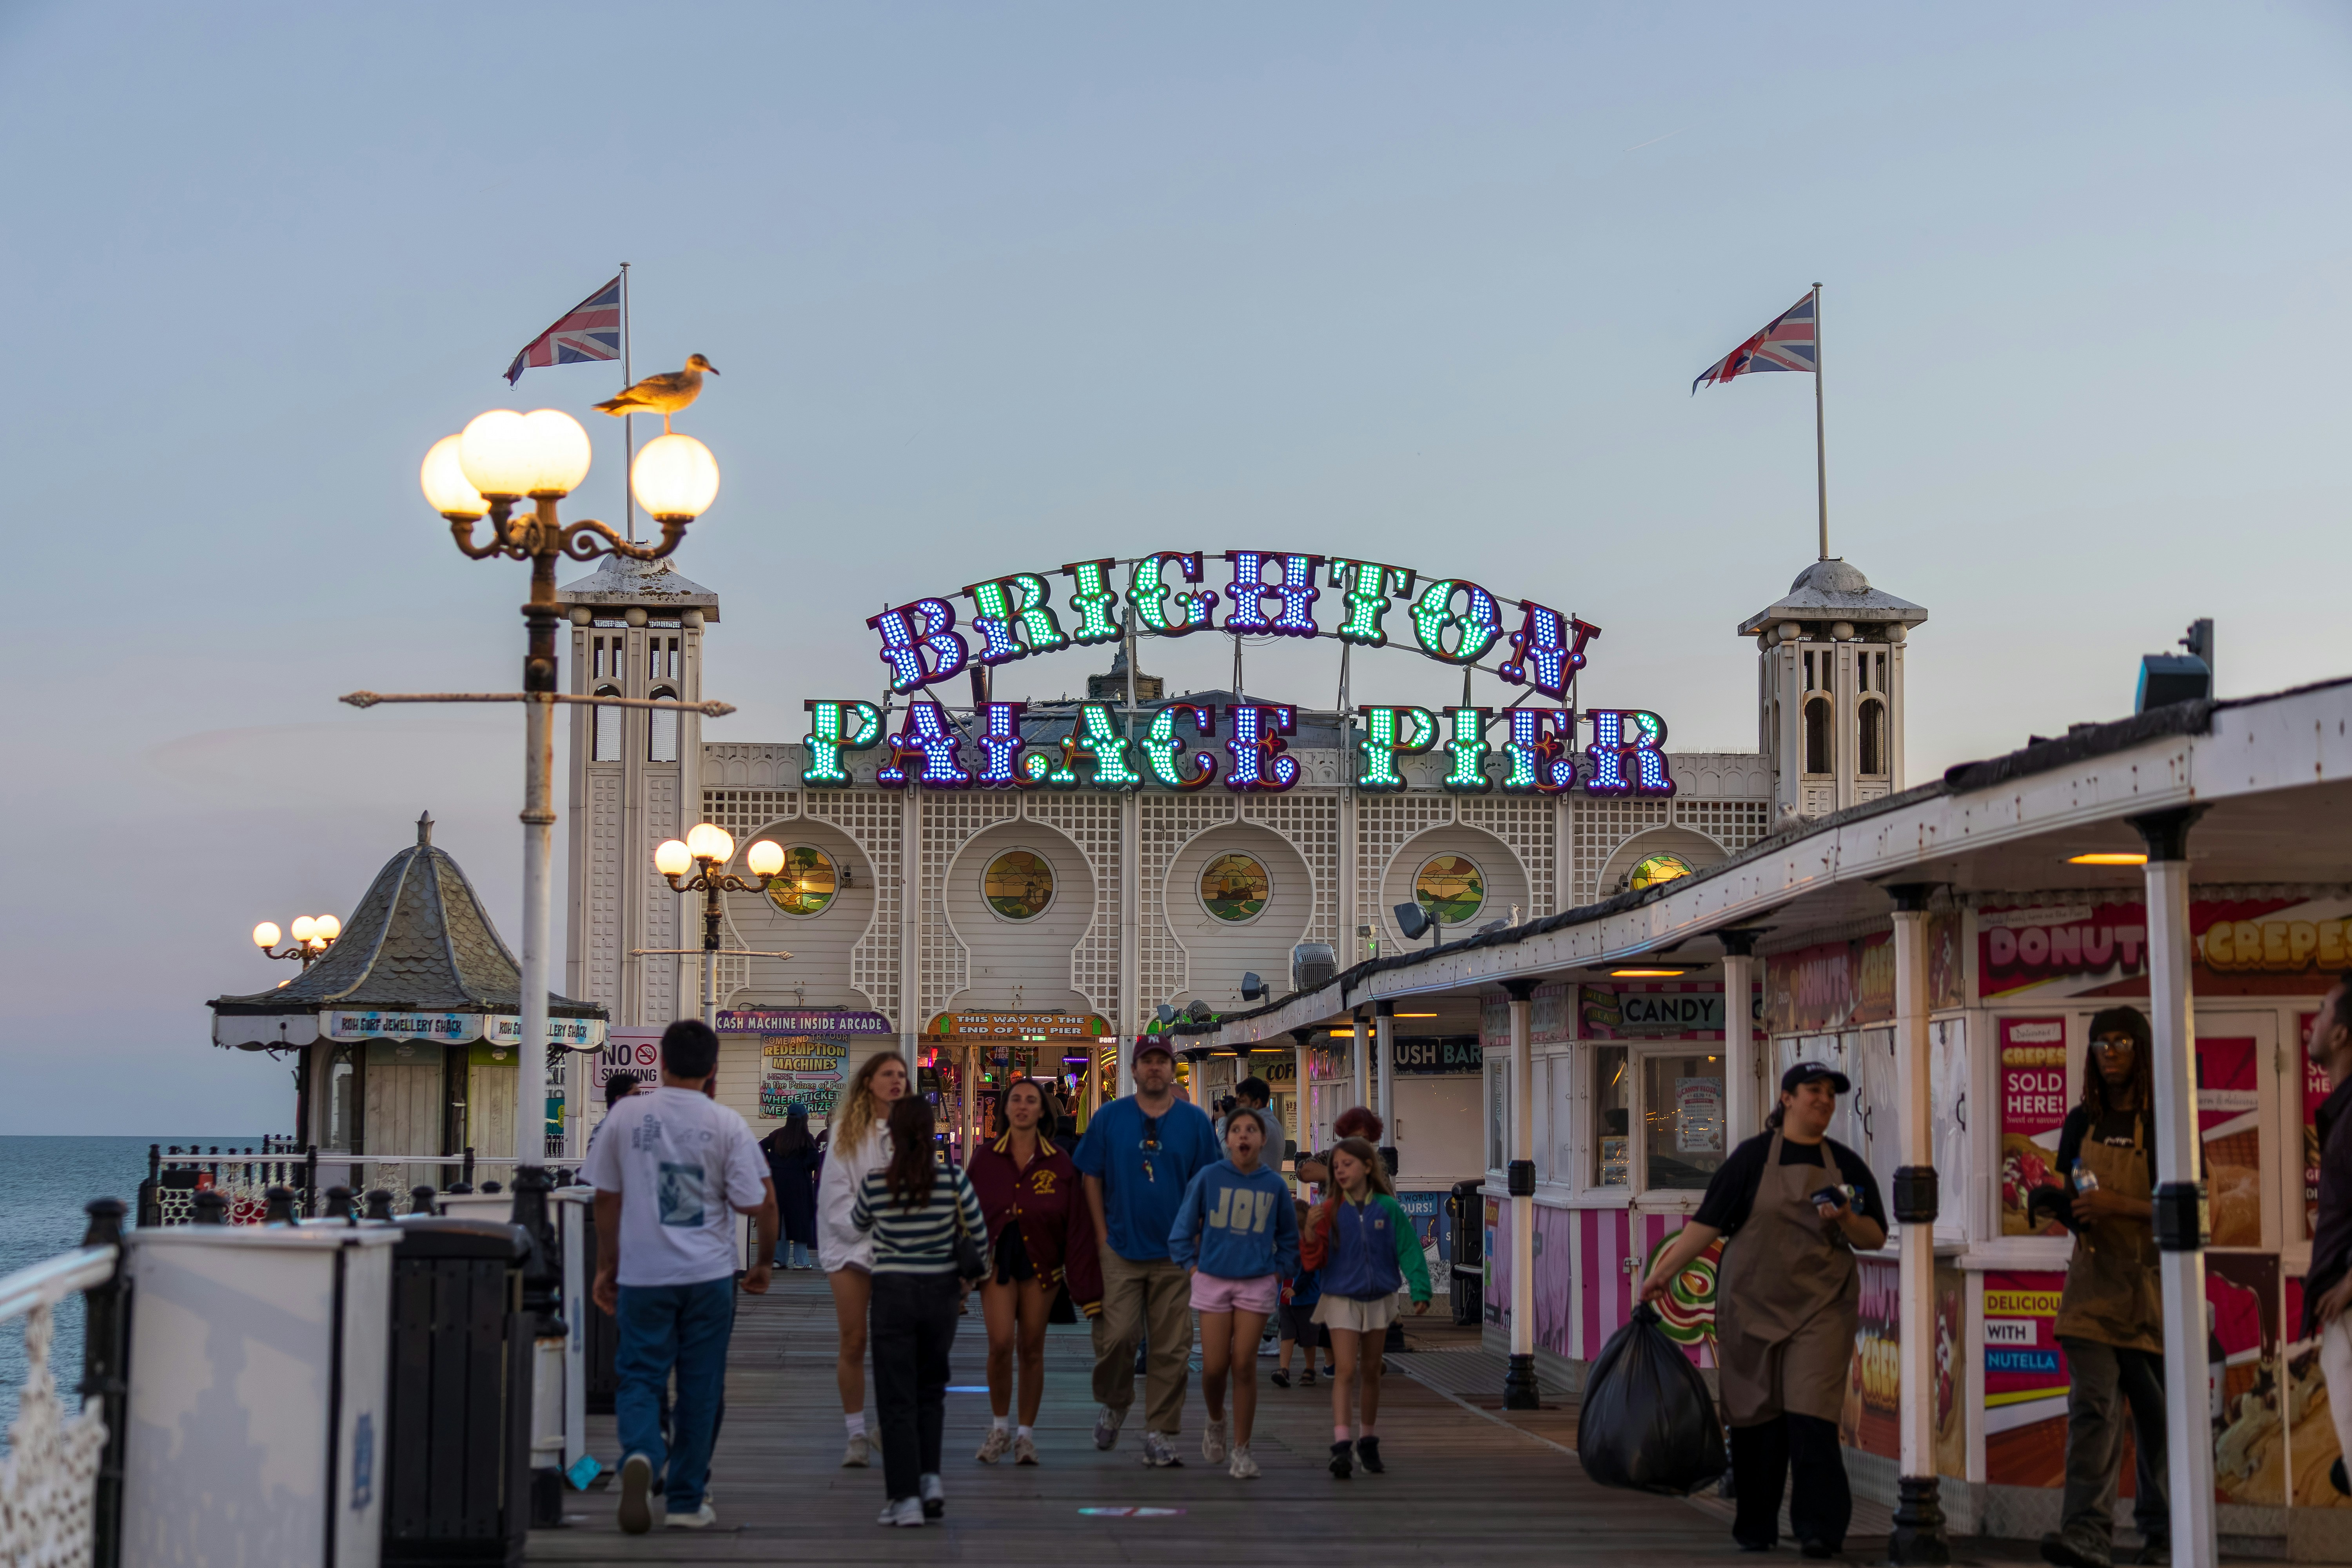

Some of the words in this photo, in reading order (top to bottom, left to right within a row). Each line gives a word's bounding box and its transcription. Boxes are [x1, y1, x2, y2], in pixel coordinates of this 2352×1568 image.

[866, 550, 1601, 699] BRIGHTON
[802, 699, 1298, 790] PALACE
[1357, 705, 1678, 799] PIER
[1989, 926, 2147, 967] DONUT
[2204, 920, 2352, 970] CREPE
[1861, 944, 1895, 1004] CREP
[1626, 998, 1715, 1022] CANDY
[360, 1018, 381, 1031] SURF
[435, 1019, 461, 1033] SHACK
[567, 1024, 587, 1038] SHACK
[716, 1017, 744, 1029] CASH
[748, 1017, 796, 1030] MACHINE
[800, 1018, 835, 1030] INSIDE
[839, 1018, 882, 1030] ARCADE
[763, 1035, 788, 1045] COME
[790, 1035, 809, 1044] AND
[829, 1033, 848, 1043] OUR
[603, 1044, 631, 1065] NO
[764, 1043, 846, 1056] REDEMPTION
[1444, 1044, 1482, 1063] BAR
[2002, 1047, 2066, 1068] CREPES
[772, 1058, 837, 1071] MACHINES
[1266, 1063, 1296, 1082] COF
[789, 1081, 816, 1089] Palace
[818, 1081, 829, 1089] of
[1681, 1086, 1699, 1094] CANDY
[1700, 1086, 1716, 1094] FLOSS
[2007, 1073, 2062, 1093] SOLD
[762, 1093, 801, 1104] WHERE
[803, 1091, 841, 1102] TICKET
[2007, 1095, 2063, 1114] HERE!
[765, 1105, 788, 1116] MEA
[1405, 1194, 1434, 1202] WORLD
[1210, 1187, 1274, 1233] JOY
[1988, 1296, 2060, 1310] DELICIOU
[1988, 1324, 2026, 1340] WITH
[1862, 1335, 1898, 1405] CREP
[1988, 1352, 2056, 1370] NUTELLA
